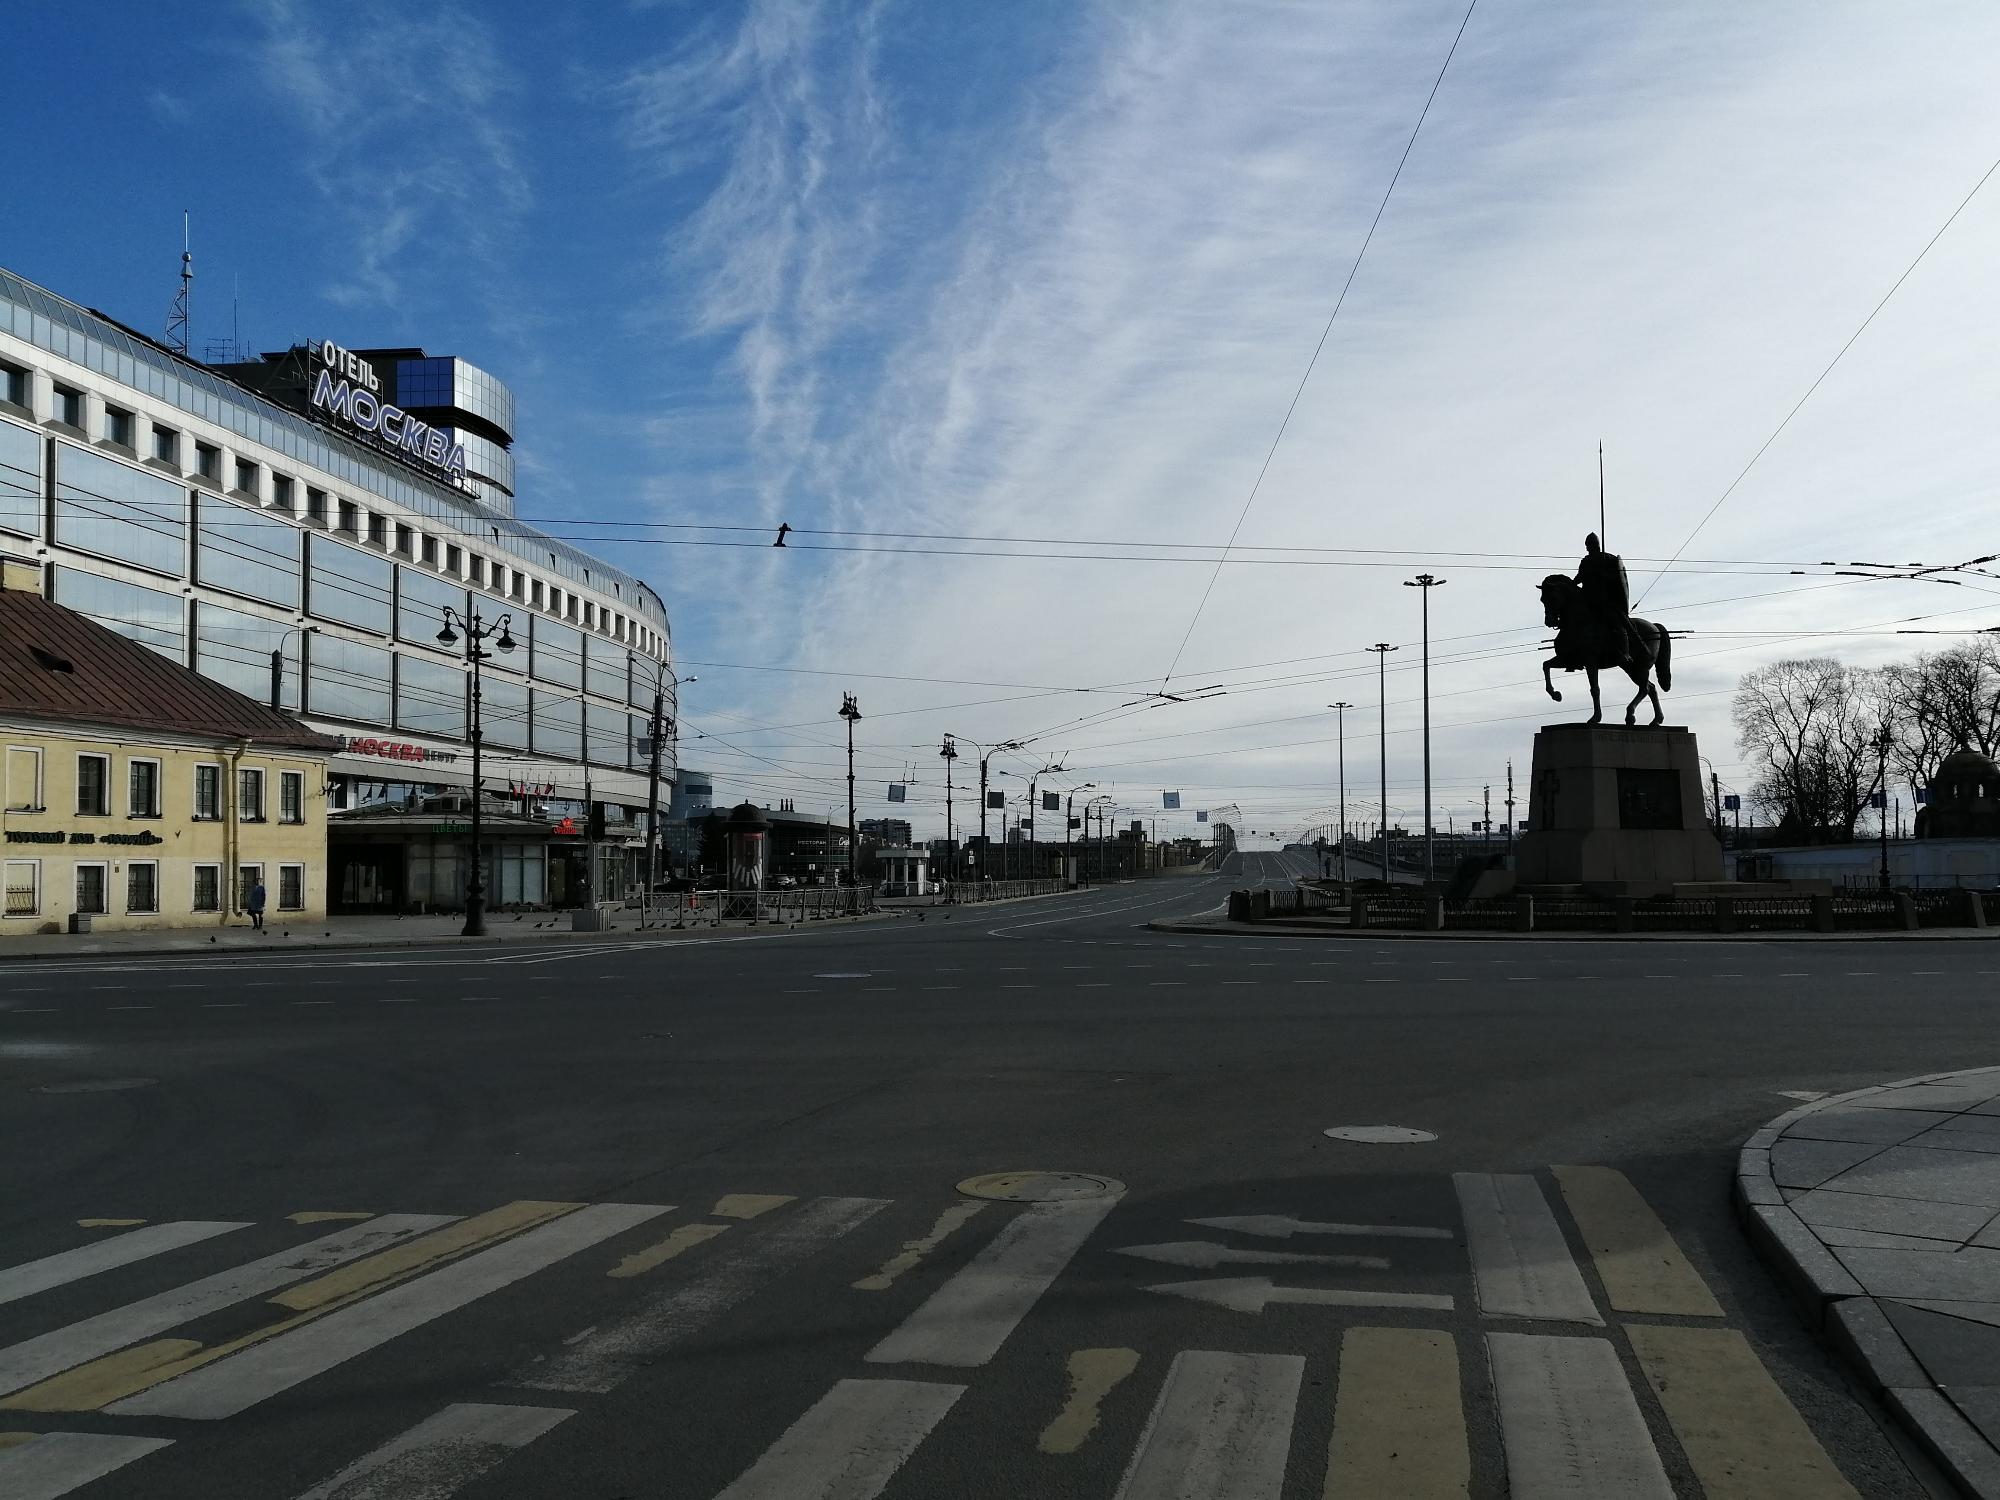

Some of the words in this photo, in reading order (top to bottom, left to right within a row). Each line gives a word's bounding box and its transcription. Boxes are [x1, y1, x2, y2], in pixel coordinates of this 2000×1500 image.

[322, 339, 379, 390] ОТЕЛЬ
[314, 369, 466, 478] МОСКВА
[348, 737, 424, 762] МОСКВА
[432, 824, 467, 833] ЦВЕТЫ
